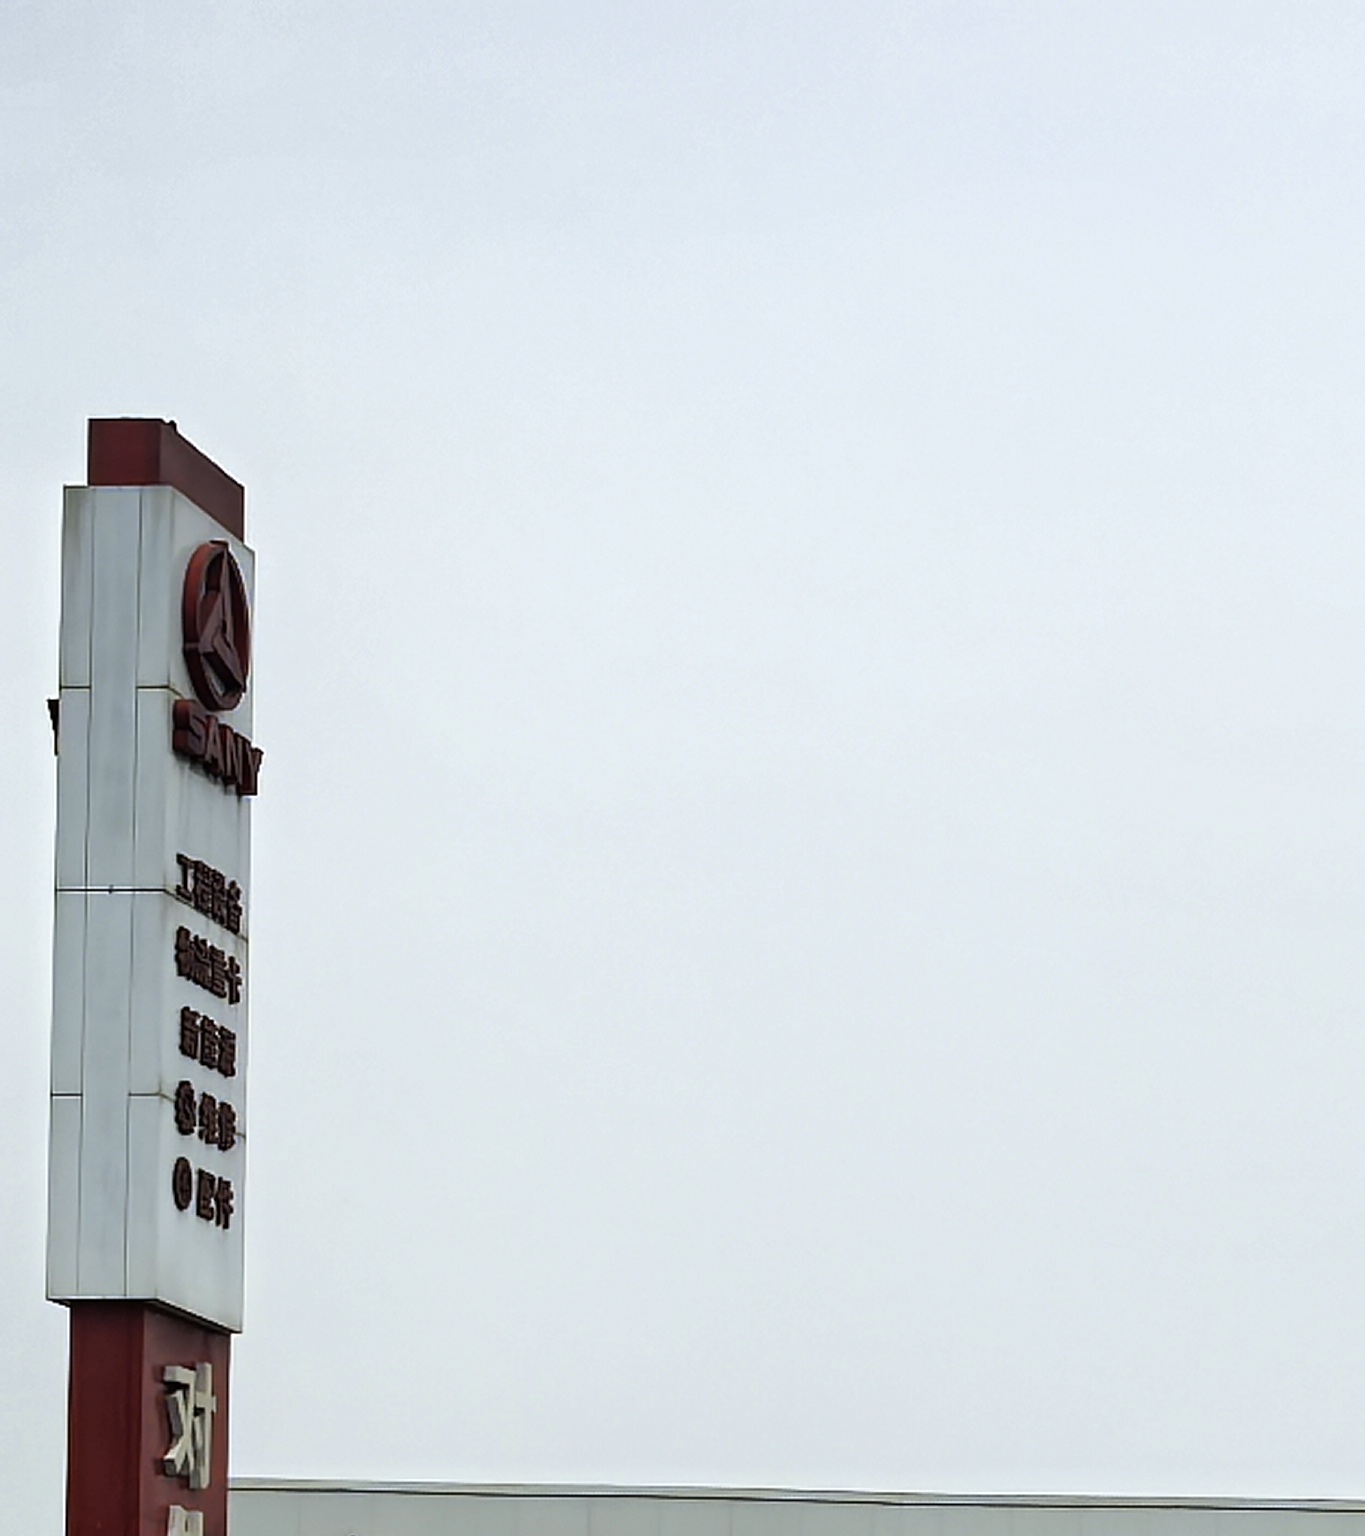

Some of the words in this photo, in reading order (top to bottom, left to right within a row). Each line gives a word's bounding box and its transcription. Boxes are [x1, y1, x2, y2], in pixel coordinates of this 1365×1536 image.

[173, 699, 264, 796] SANY
[179, 1006, 237, 1077] 新能源
